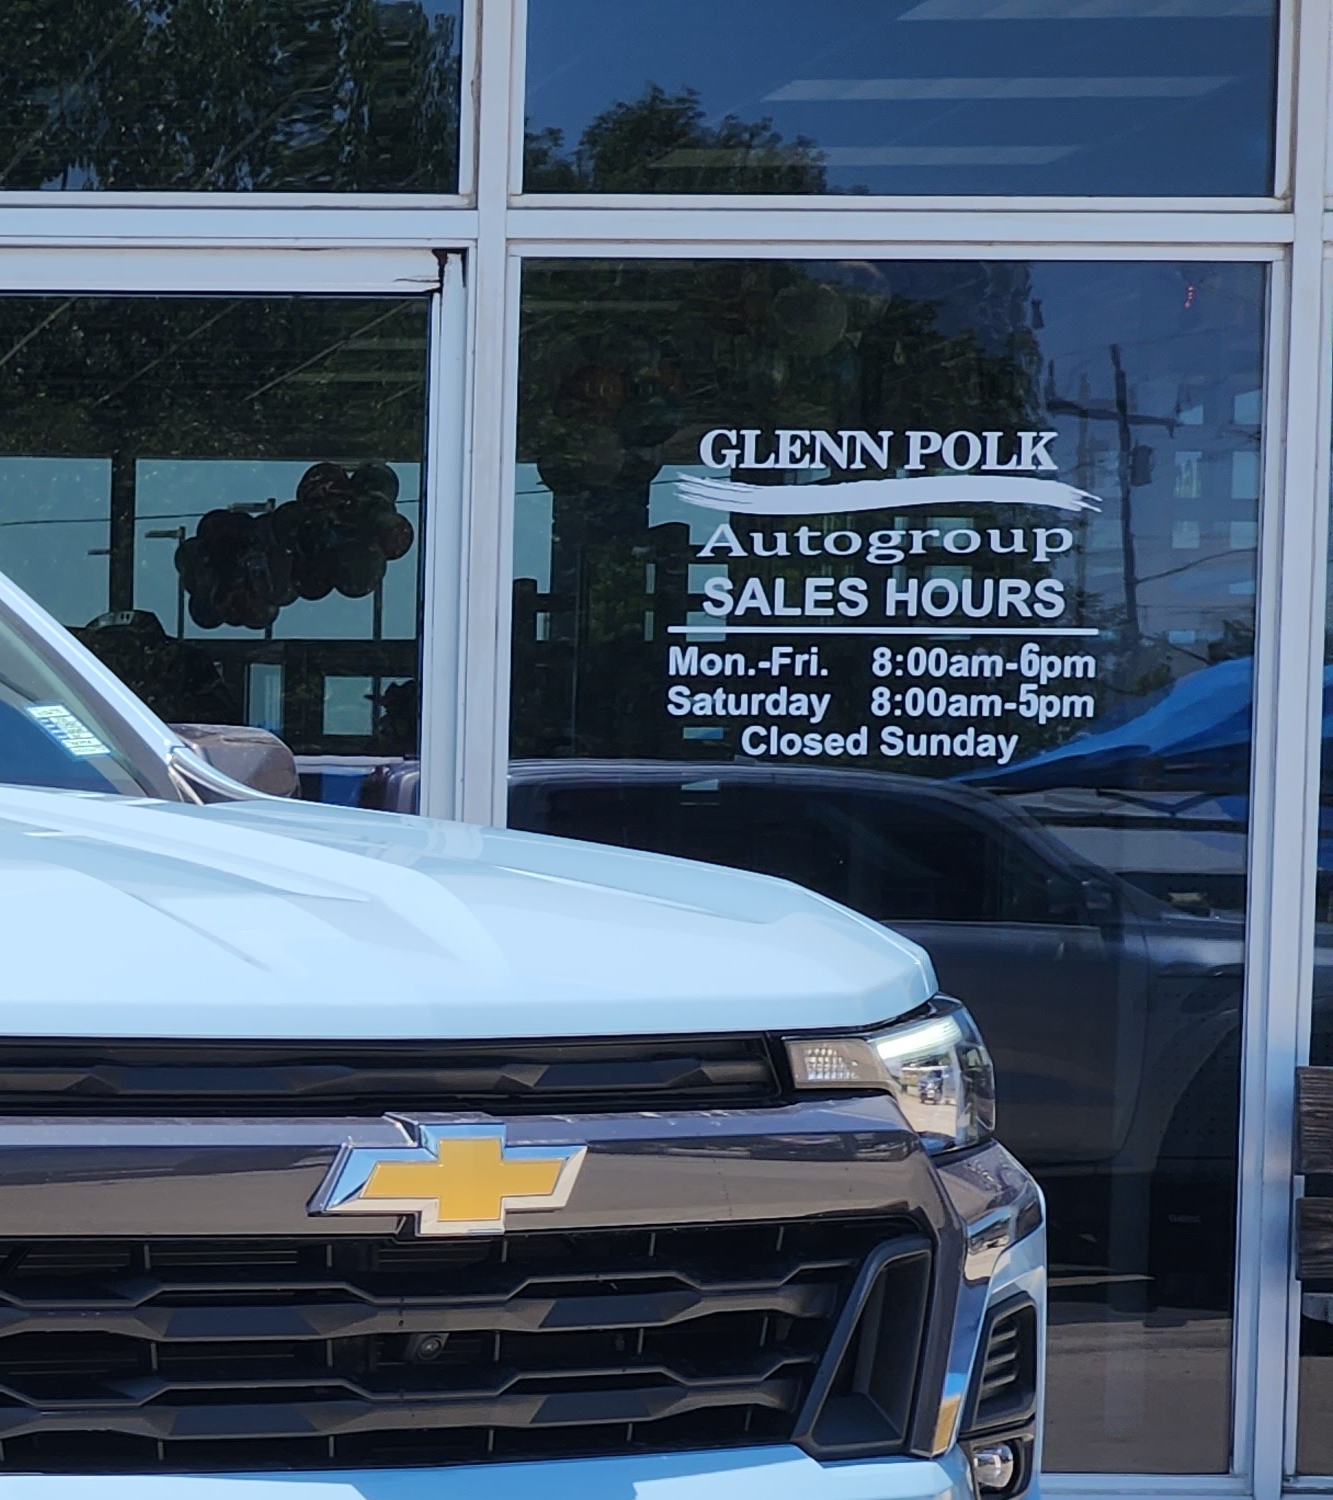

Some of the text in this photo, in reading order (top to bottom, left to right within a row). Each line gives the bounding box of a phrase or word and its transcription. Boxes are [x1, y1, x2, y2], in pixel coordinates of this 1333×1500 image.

[699, 429, 1059, 471] GLENN POLK
[695, 523, 1074, 565] Autogroup
[702, 576, 1065, 618] SALES HOURS
[668, 643, 1096, 685] Mon.-Fri. 8:00am-6pm
[667, 684, 1095, 725] Saturday 8:00am-5pm
[740, 725, 1019, 765] Closed Sunday
